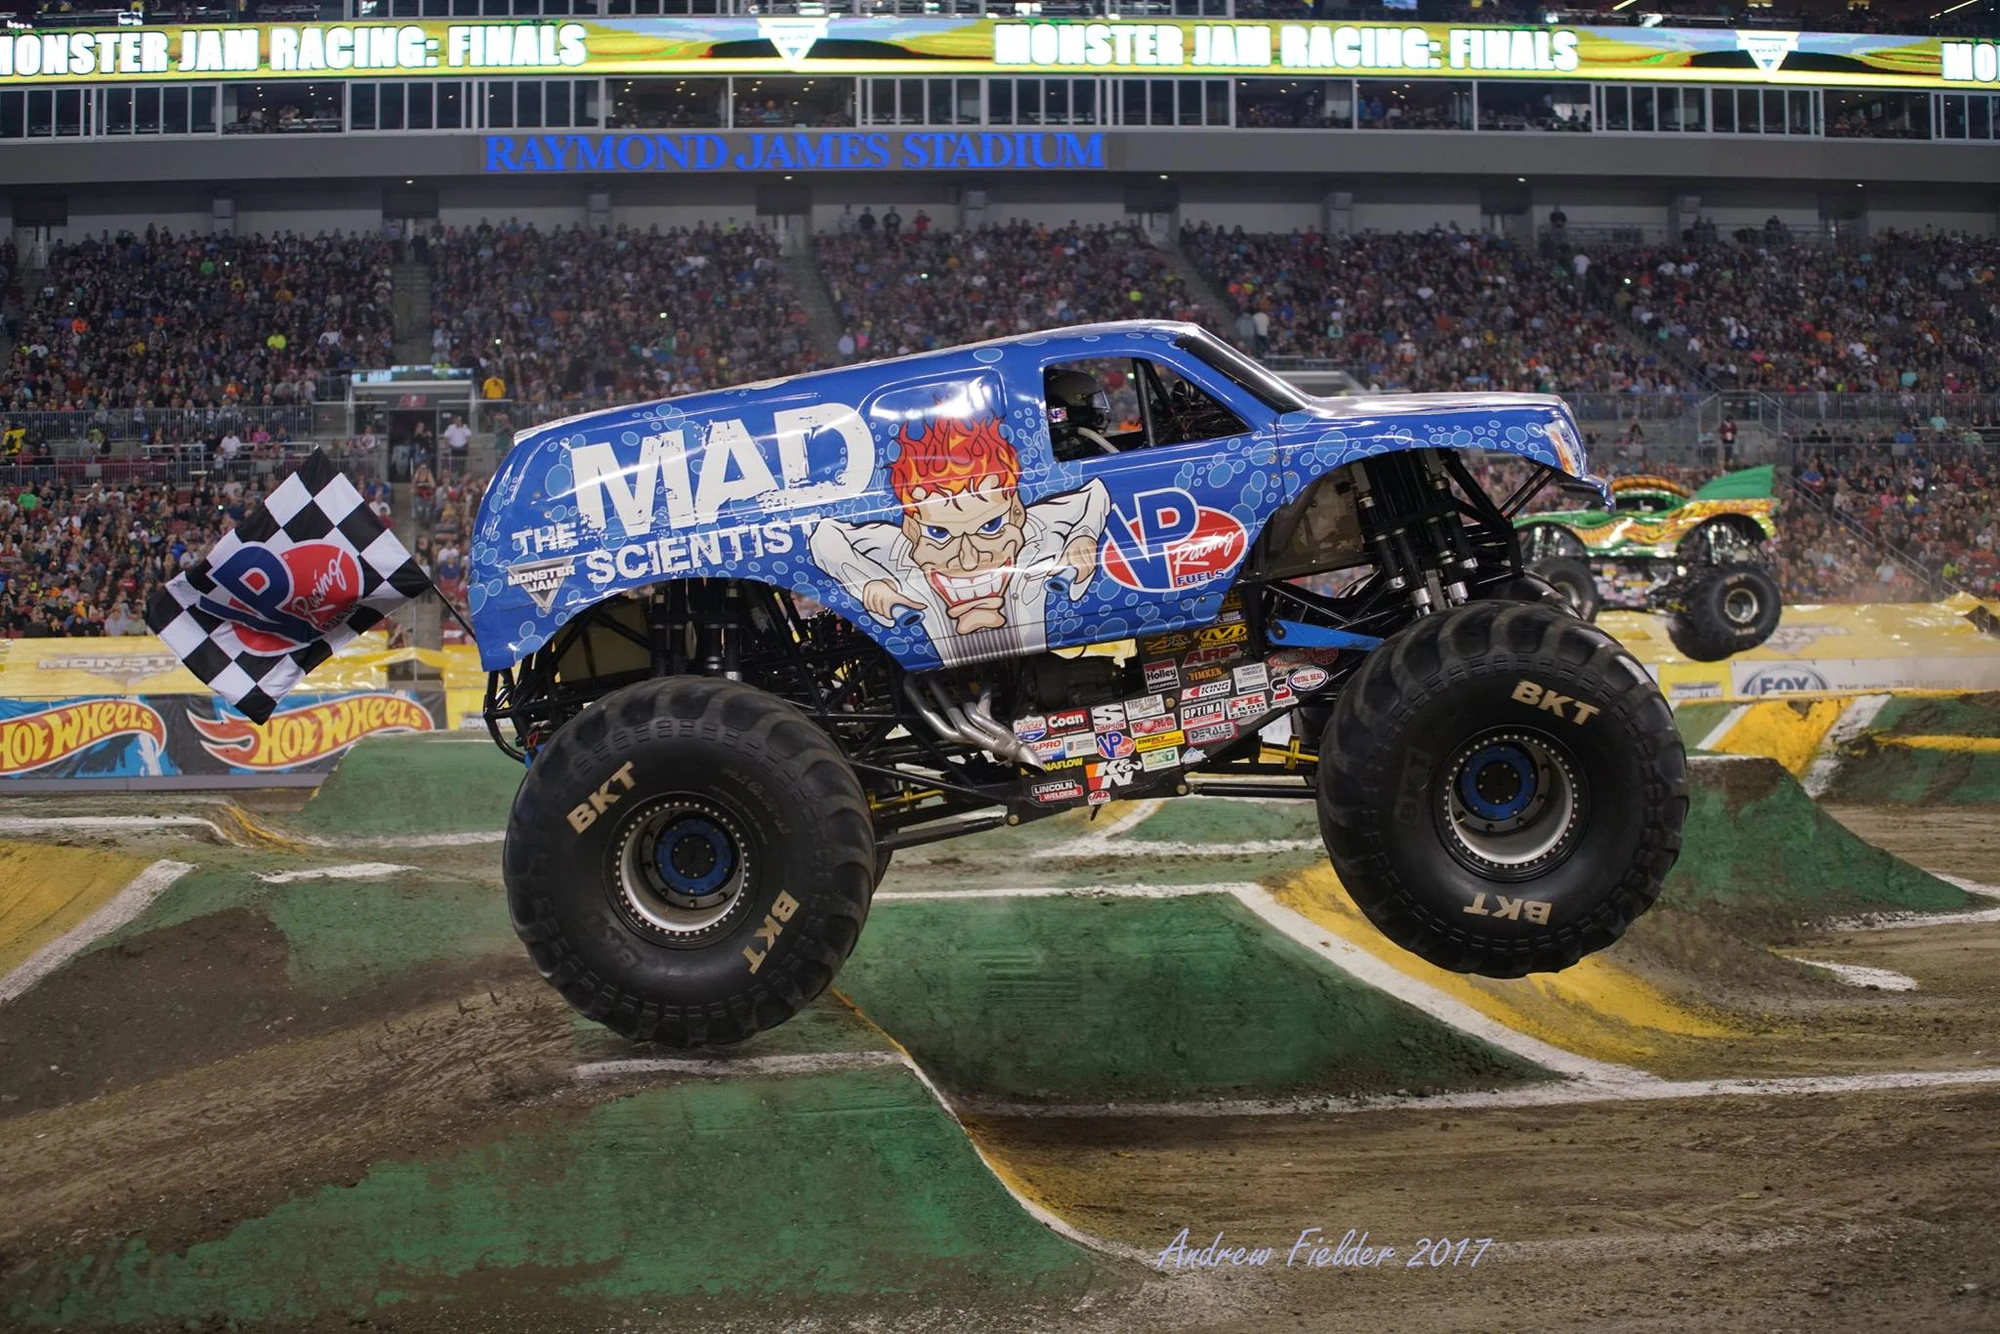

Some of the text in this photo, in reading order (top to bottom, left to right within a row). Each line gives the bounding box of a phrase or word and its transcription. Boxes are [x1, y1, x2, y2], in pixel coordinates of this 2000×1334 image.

[178, 28, 259, 72] JAM
[270, 26, 438, 70] RACING:
[448, 24, 588, 68] FINALS
[995, 24, 1579, 72] MONSTER JAM RACING: FINALS
[1941, 42, 2000, 82] MO
[485, 131, 1106, 173] RAYMOND JAMES STADIUM
[570, 402, 876, 538] MAD
[511, 522, 579, 556] THE
[585, 512, 822, 584] SCIENTIST
[1105, 487, 1198, 590] VP
[1172, 529, 1244, 576] Racing
[291, 548, 347, 624] Racing
[508, 565, 576, 587] MONSTER
[527, 578, 558, 593] JAM
[1176, 569, 1225, 587] FUELS
[36, 656, 186, 671] MONST
[1146, 668, 1177, 682] Holley
[1293, 672, 1324, 684] TOTAL SEAL
[1201, 682, 1230, 695] KING
[1510, 679, 1600, 726] BKT
[1048, 714, 1085, 729] Coan
[1184, 702, 1221, 720] OPTIMA
[1097, 731, 1124, 760] VP
[1190, 723, 1232, 740] DERALE
[565, 760, 637, 836] BKT
[1034, 780, 1074, 794] LINCOLN
[1044, 789, 1078, 801] WELDERS
[1463, 892, 1553, 925] BKT
[741, 889, 800, 975] BKT
